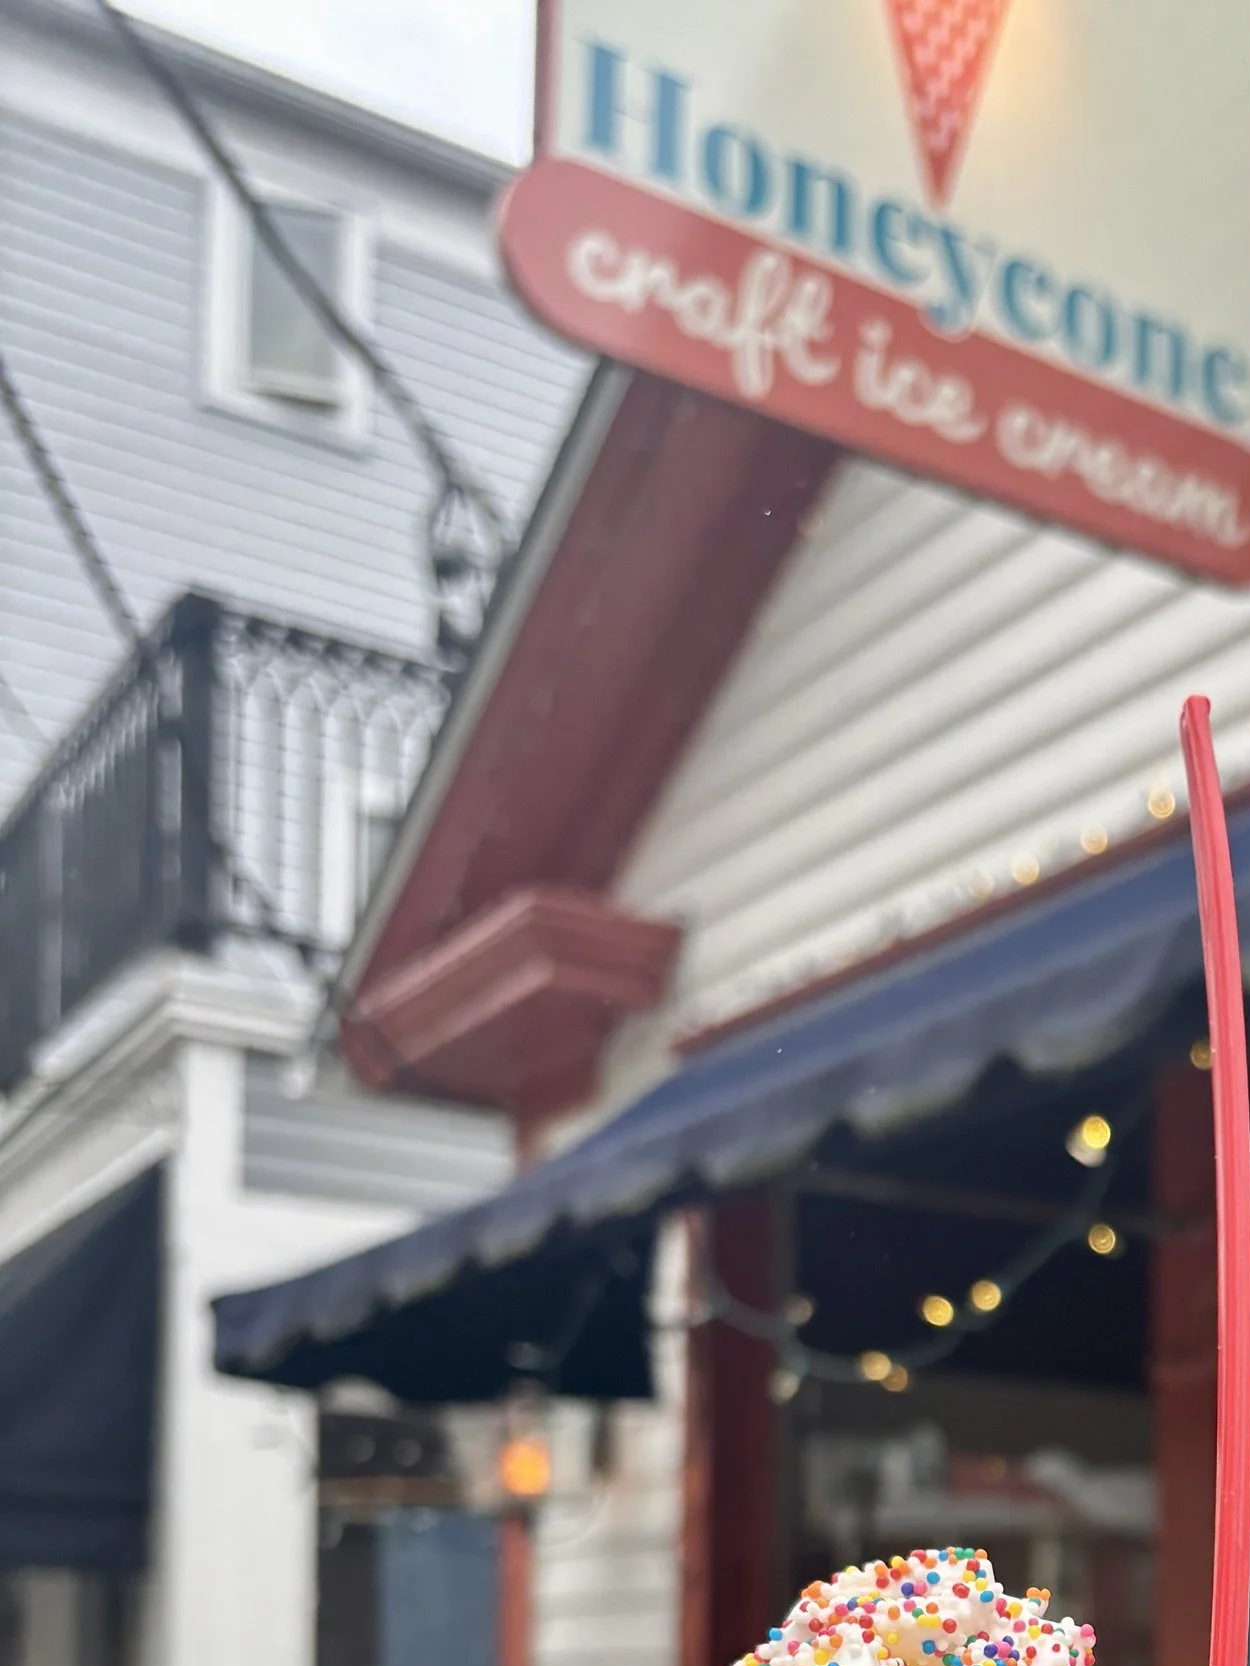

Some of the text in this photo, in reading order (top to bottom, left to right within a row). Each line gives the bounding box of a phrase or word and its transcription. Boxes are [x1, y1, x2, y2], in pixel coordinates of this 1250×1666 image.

[566, 228, 1250, 549] craft ice cream
